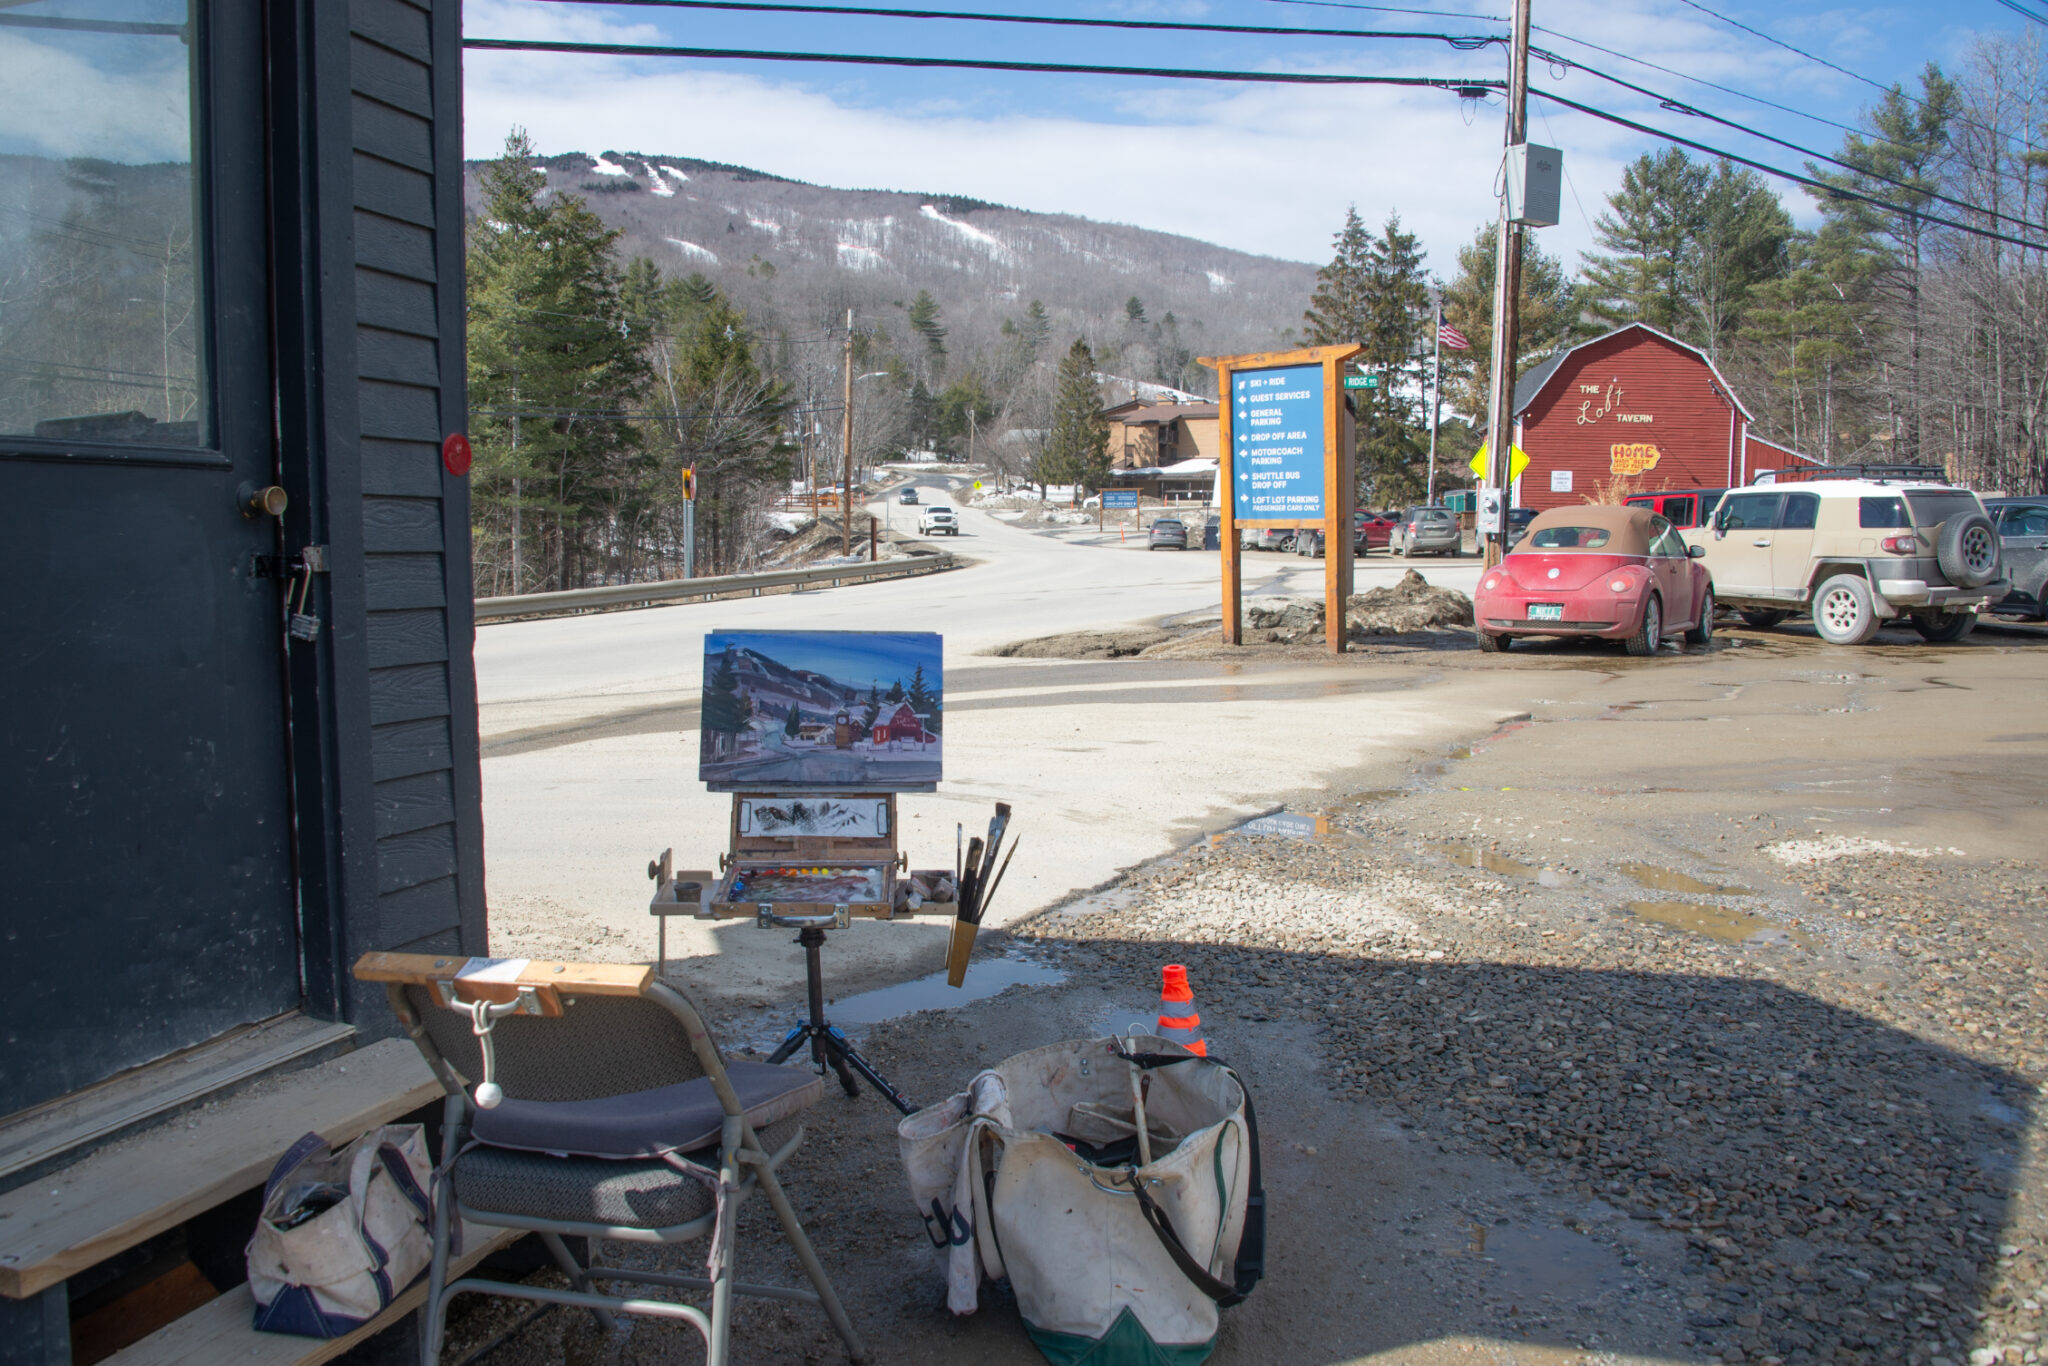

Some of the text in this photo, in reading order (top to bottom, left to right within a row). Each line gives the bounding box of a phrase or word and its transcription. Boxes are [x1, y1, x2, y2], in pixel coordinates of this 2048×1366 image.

[1250, 379, 1262, 388] SKI
[1269, 377, 1286, 386] RIDE
[1348, 377, 1368, 386] RIDGE
[1580, 385, 1600, 394] THE
[1250, 391, 1311, 403] GUEST SERVICES
[1577, 384, 1624, 425] Loft
[1251, 409, 1283, 417] GENERAL
[1251, 418, 1282, 426] PARKING
[1616, 413, 1653, 423] TAVERN
[1251, 431, 1307, 442] DROP OFF AREA
[1251, 447, 1303, 456] MOTORCOACH
[1614, 446, 1654, 458] HOME
[1251, 457, 1282, 465] PARKING
[1252, 471, 1300, 480] SHUTTLE BUS
[1252, 481, 1272, 489] DROP
[1252, 495, 1319, 504] LOFT LOT PARKING
[1252, 504, 1320, 512] PASSENGER CARS ONLY
